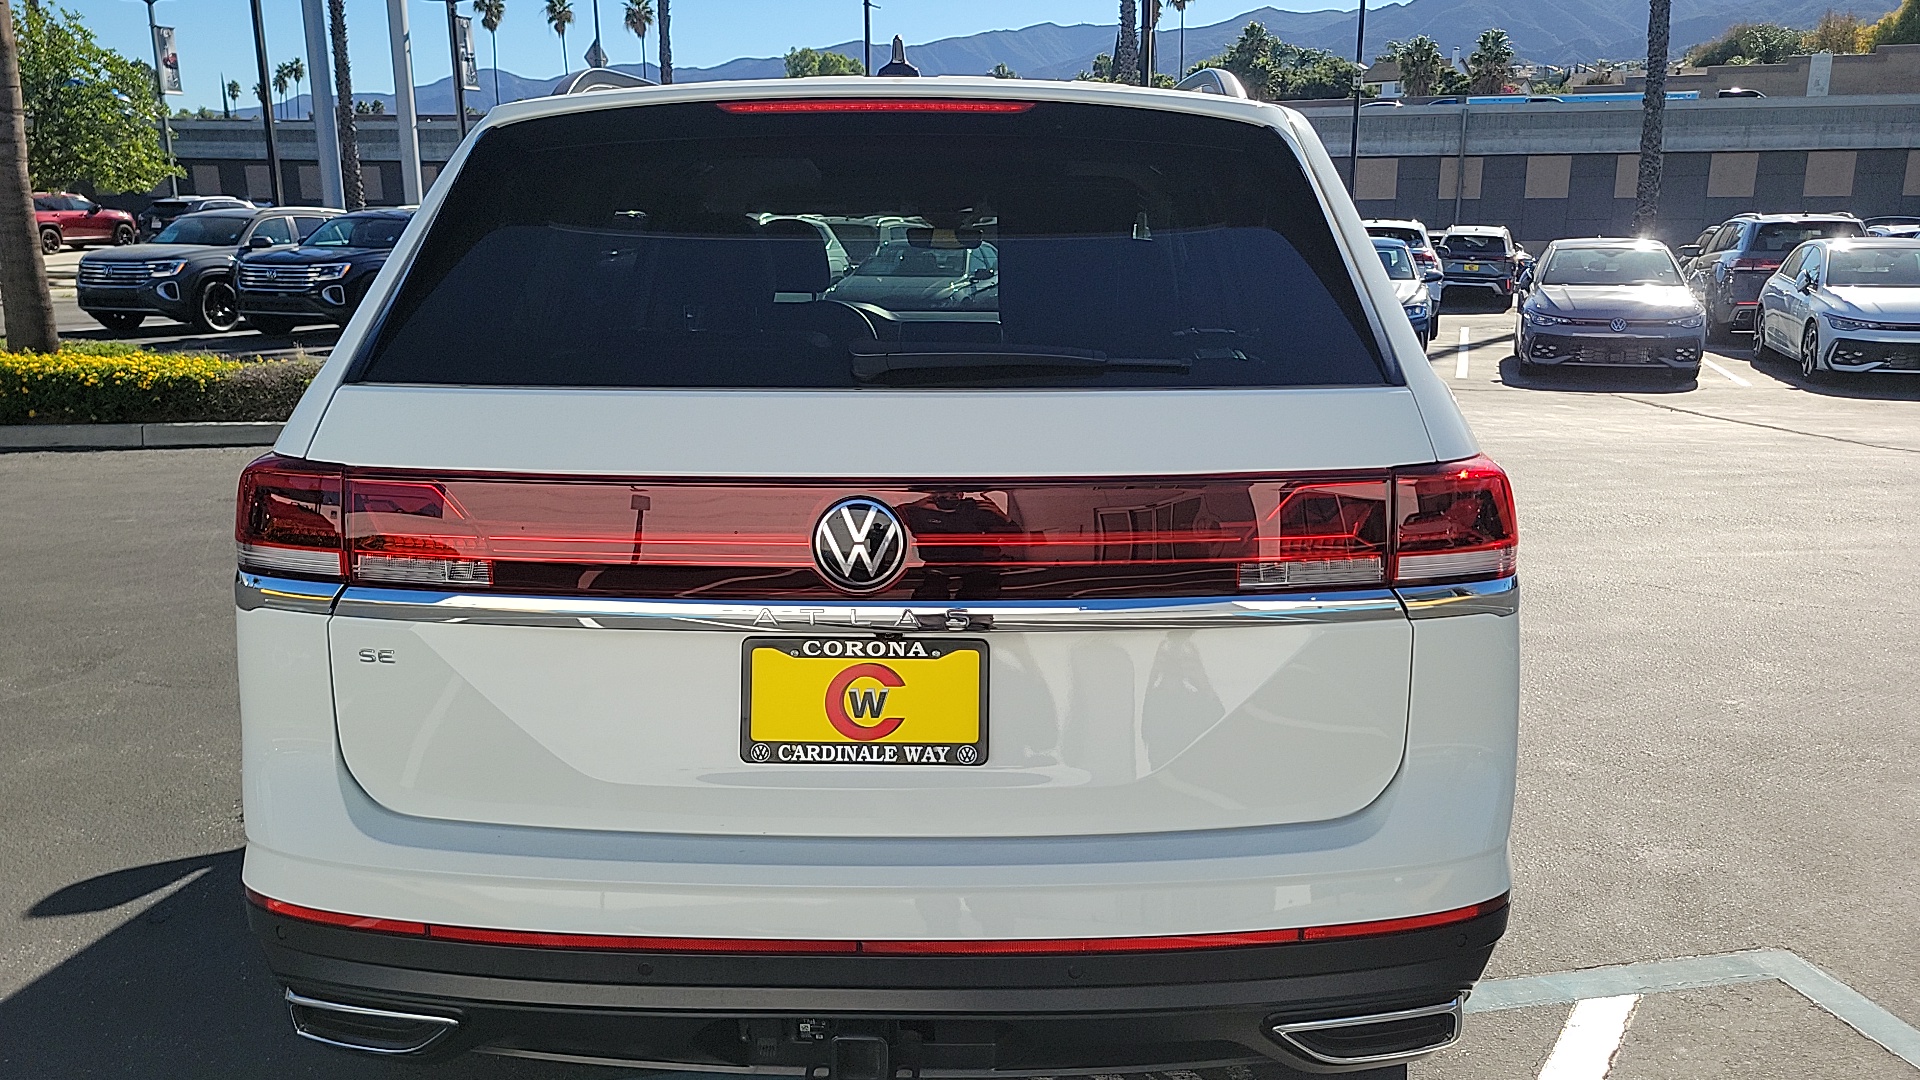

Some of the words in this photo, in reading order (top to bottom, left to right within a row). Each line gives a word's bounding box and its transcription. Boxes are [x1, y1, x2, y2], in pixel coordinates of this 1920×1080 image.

[815, 498, 904, 585] VW
[753, 607, 970, 631] ATLAS
[359, 648, 396, 664] SE
[802, 640, 929, 658] CORONA
[751, 743, 771, 762] VW
[778, 744, 898, 763] CARDINALE
[903, 746, 951, 763] WAY
[957, 745, 978, 764] VW
